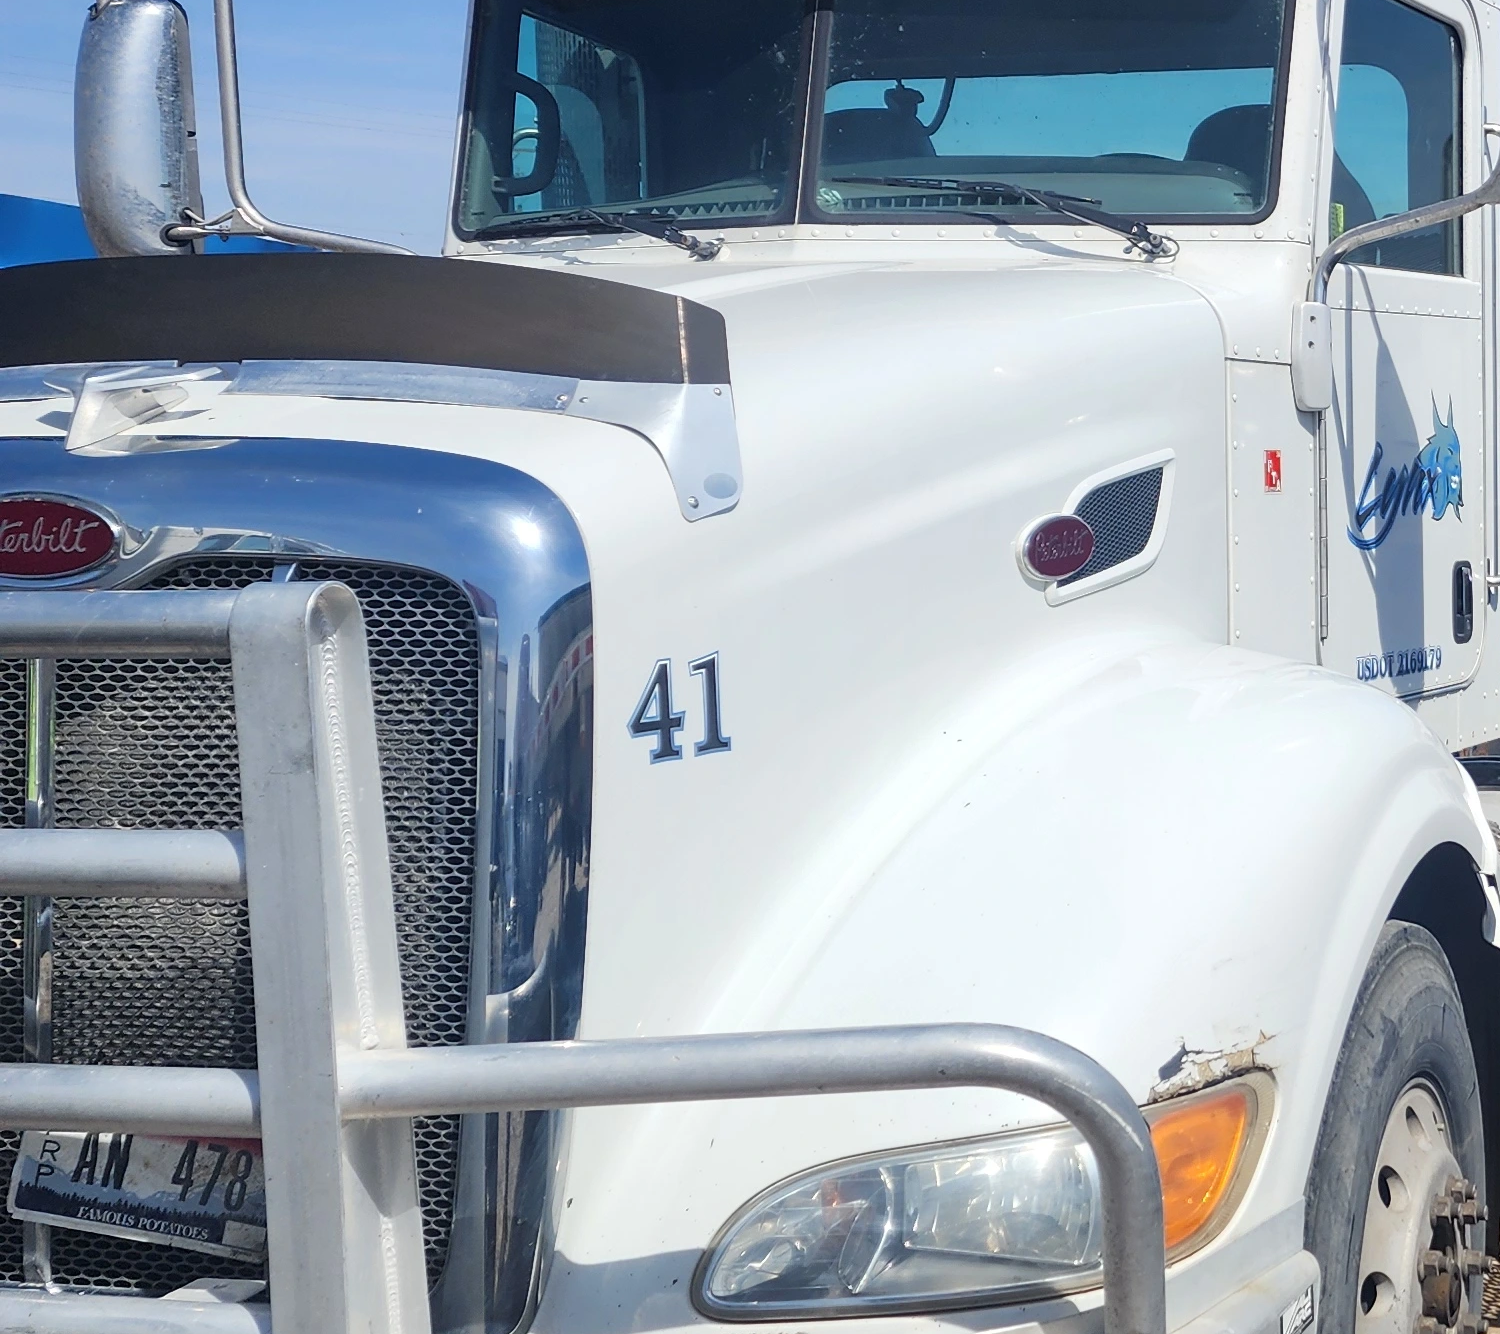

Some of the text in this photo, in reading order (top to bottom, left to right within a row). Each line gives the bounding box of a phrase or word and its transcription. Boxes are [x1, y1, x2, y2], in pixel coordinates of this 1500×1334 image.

[1346, 441, 1442, 551] Lynx
[1356, 645, 1442, 682] USDOT 2169179
[626, 650, 732, 765] 41
[171, 1139, 253, 1212] 478
[76, 1206, 208, 1240] FAMOUS POTATOES
